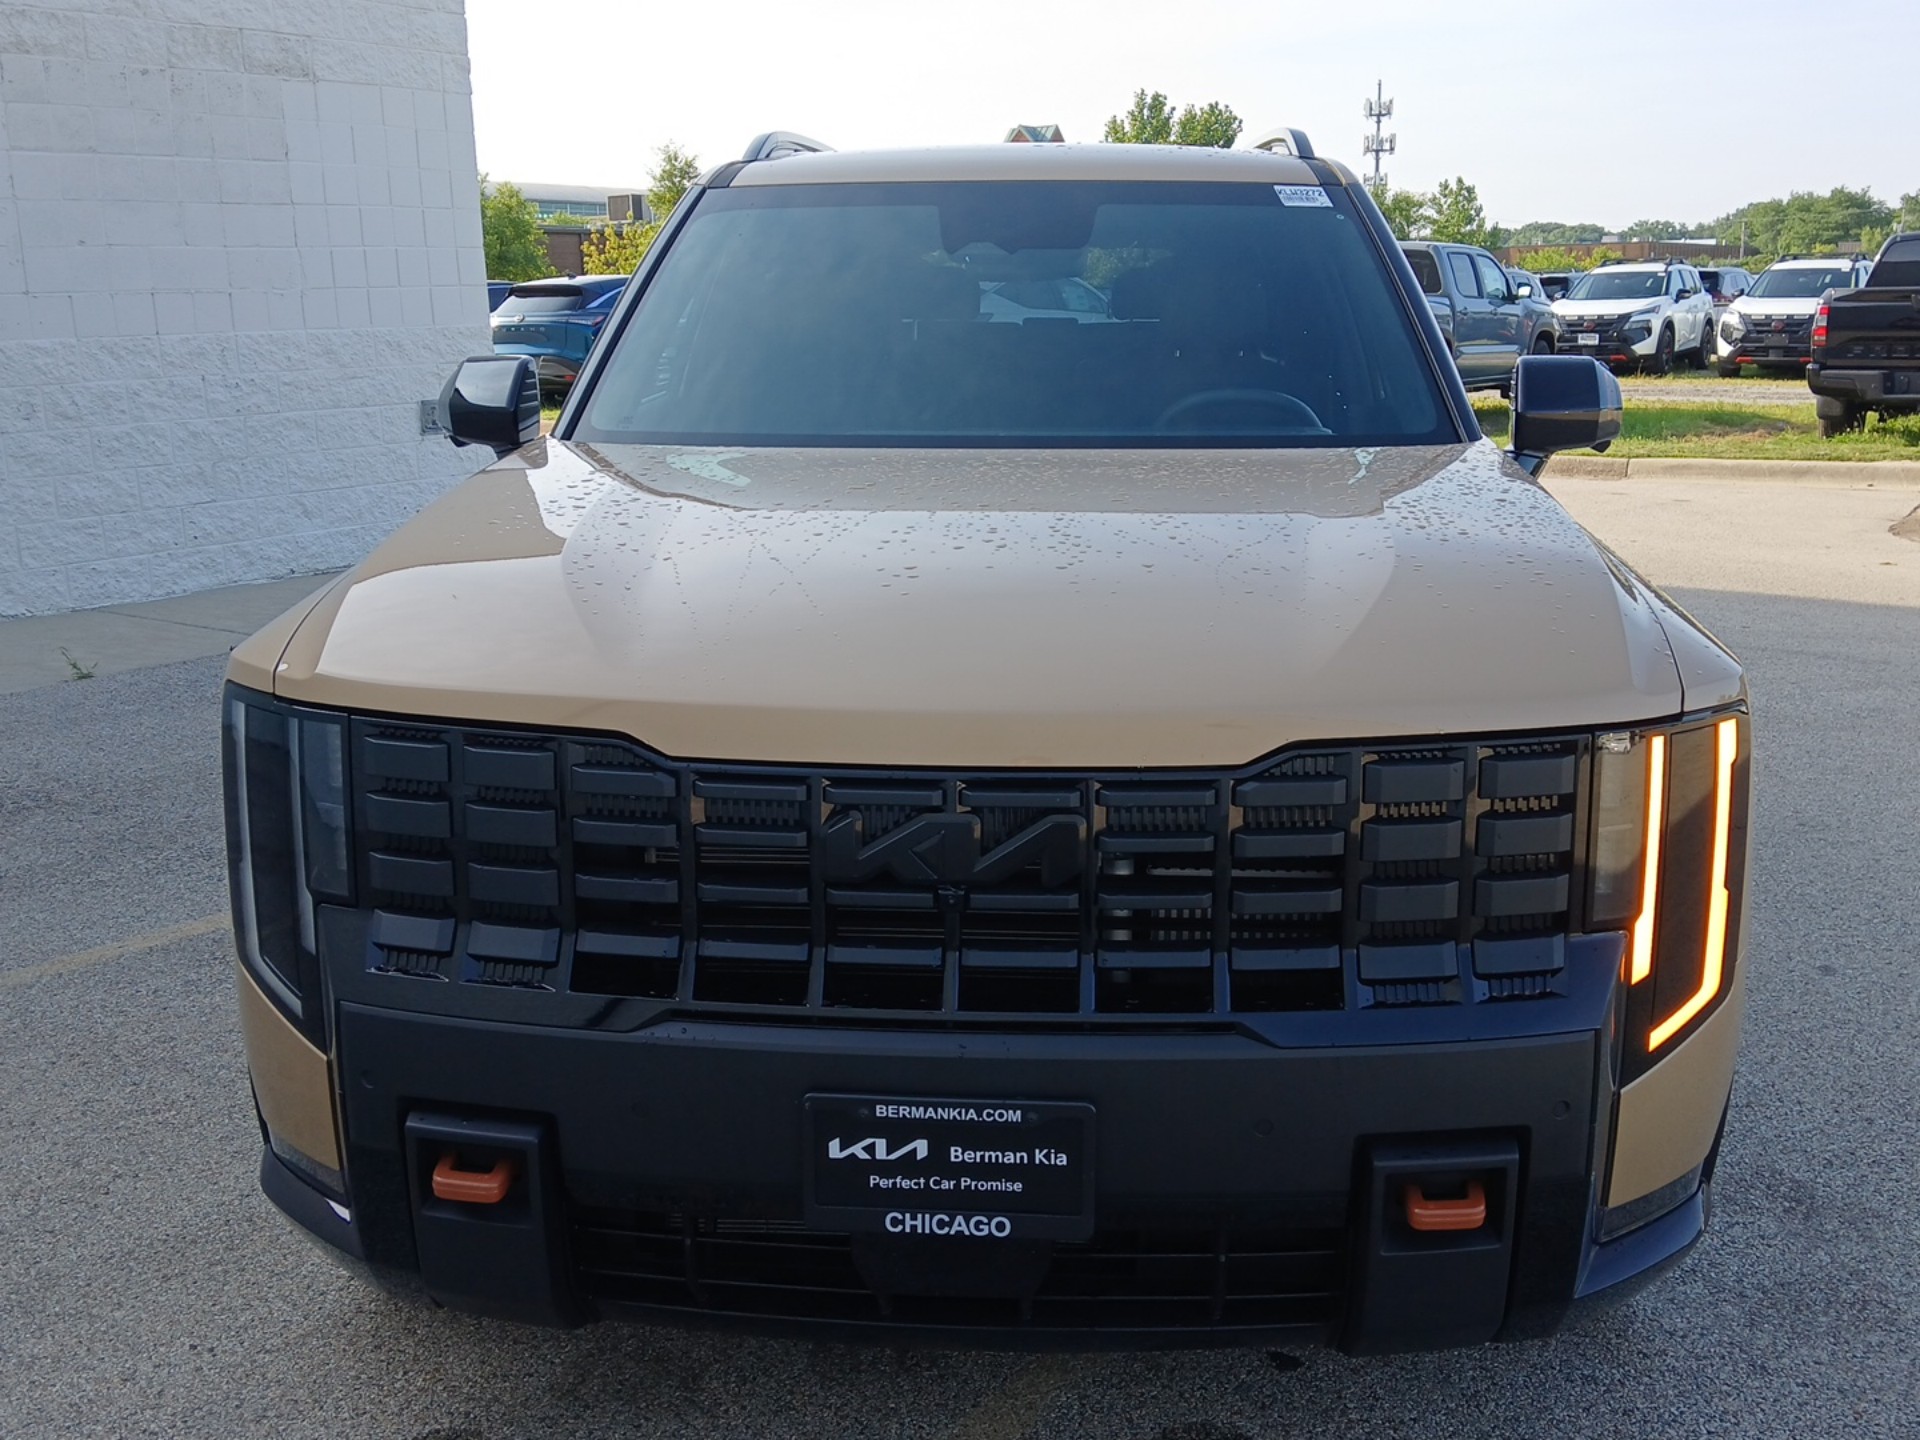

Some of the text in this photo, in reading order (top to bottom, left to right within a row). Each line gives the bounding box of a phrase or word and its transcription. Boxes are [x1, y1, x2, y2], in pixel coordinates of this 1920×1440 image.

[820, 810, 1087, 886] KIA
[875, 1104, 1022, 1122] BERMANKIA.COM
[828, 1137, 929, 1161] KIA
[949, 1146, 1068, 1166] Berman Kia
[869, 1175, 1023, 1192] Perfect Car Promise
[884, 1212, 1012, 1237] CHICAGO
